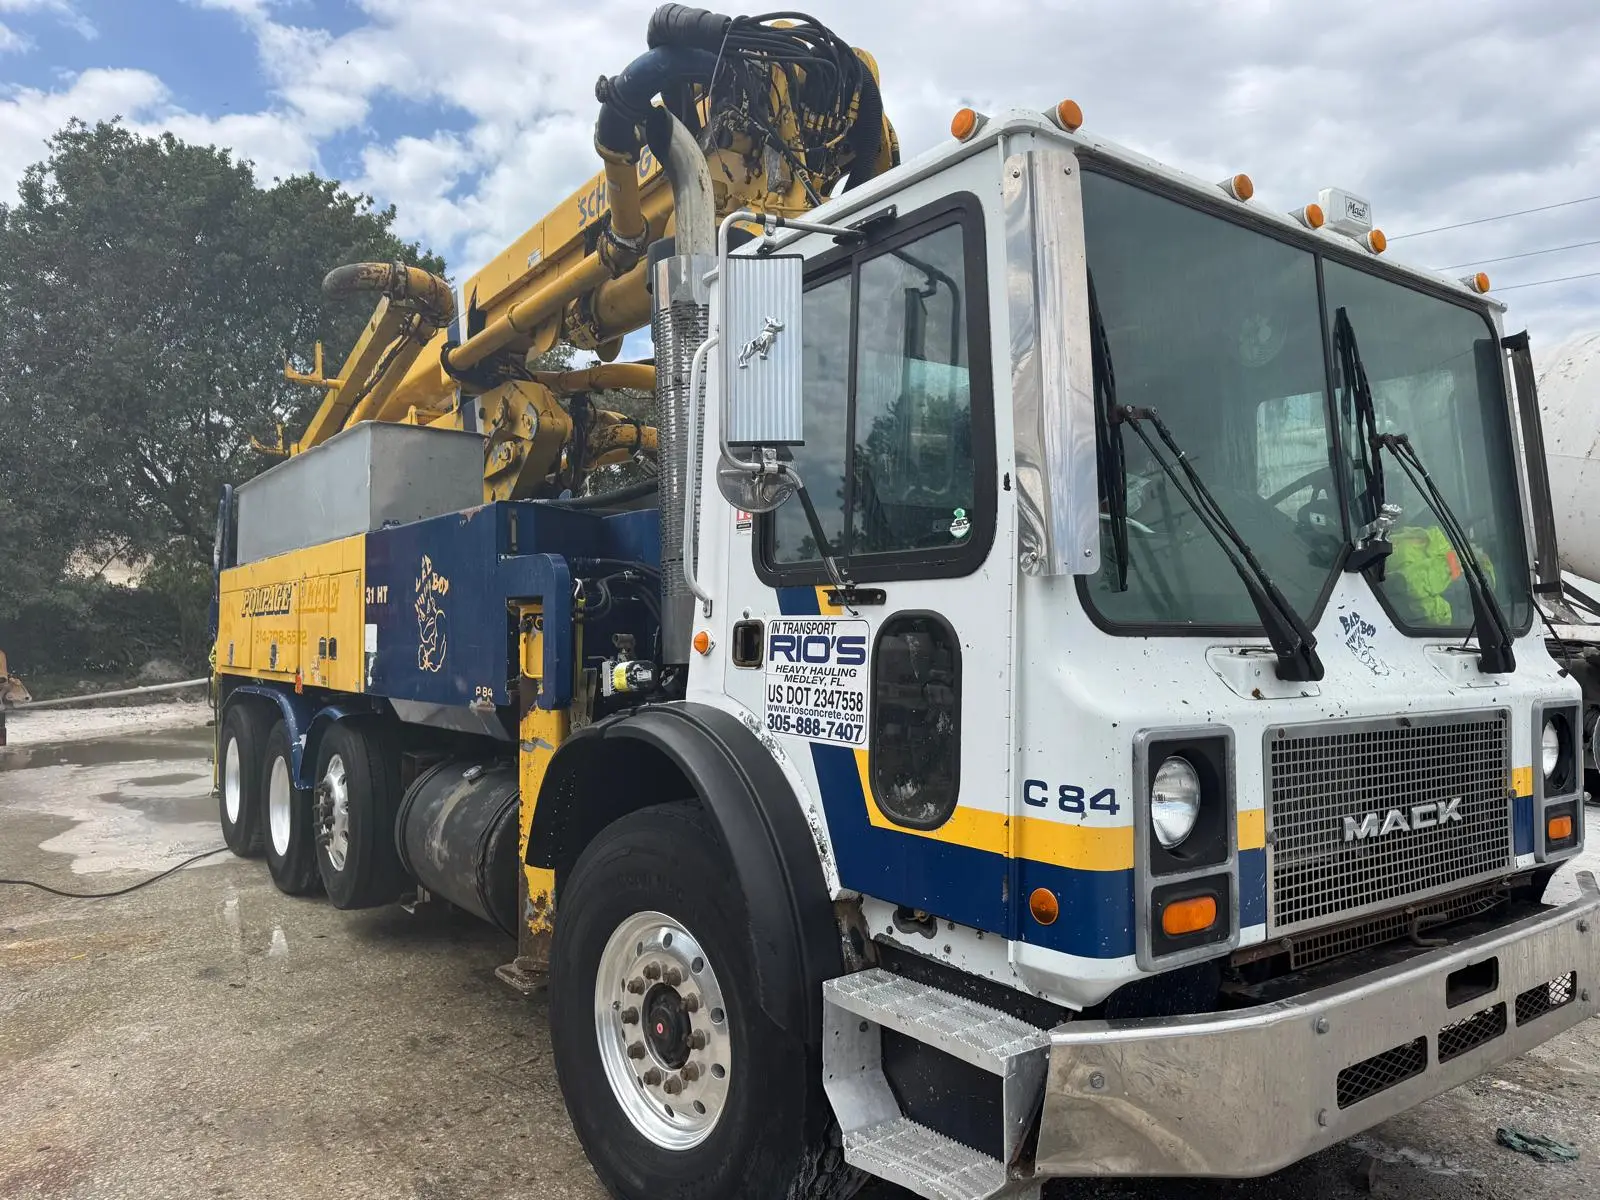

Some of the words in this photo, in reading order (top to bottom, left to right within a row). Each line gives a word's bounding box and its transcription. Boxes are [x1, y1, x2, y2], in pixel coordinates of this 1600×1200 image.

[241, 582, 292, 617] POMPAGE
[366, 587, 375, 605] 31
[376, 585, 388, 603] HT
[771, 622, 780, 634] IN
[782, 622, 837, 635] TRANSPORT
[1338, 611, 1361, 635] BAD
[1360, 620, 1377, 637] BOY
[769, 635, 866, 666] RIO'S
[775, 664, 808, 675] HEAVY
[809, 666, 857, 678] HAULING
[783, 674, 827, 686] MEDLEY,
[830, 677, 845, 687] FL.
[768, 684, 783, 704] US
[786, 685, 811, 706] DOT
[814, 688, 863, 712] 2347558
[767, 703, 865, 724] www.riosconcrete.com
[767, 712, 863, 742] 305-888-7407
[1023, 779, 1048, 808] C
[1058, 784, 1120, 815] 84
[1342, 797, 1462, 842] MACK
